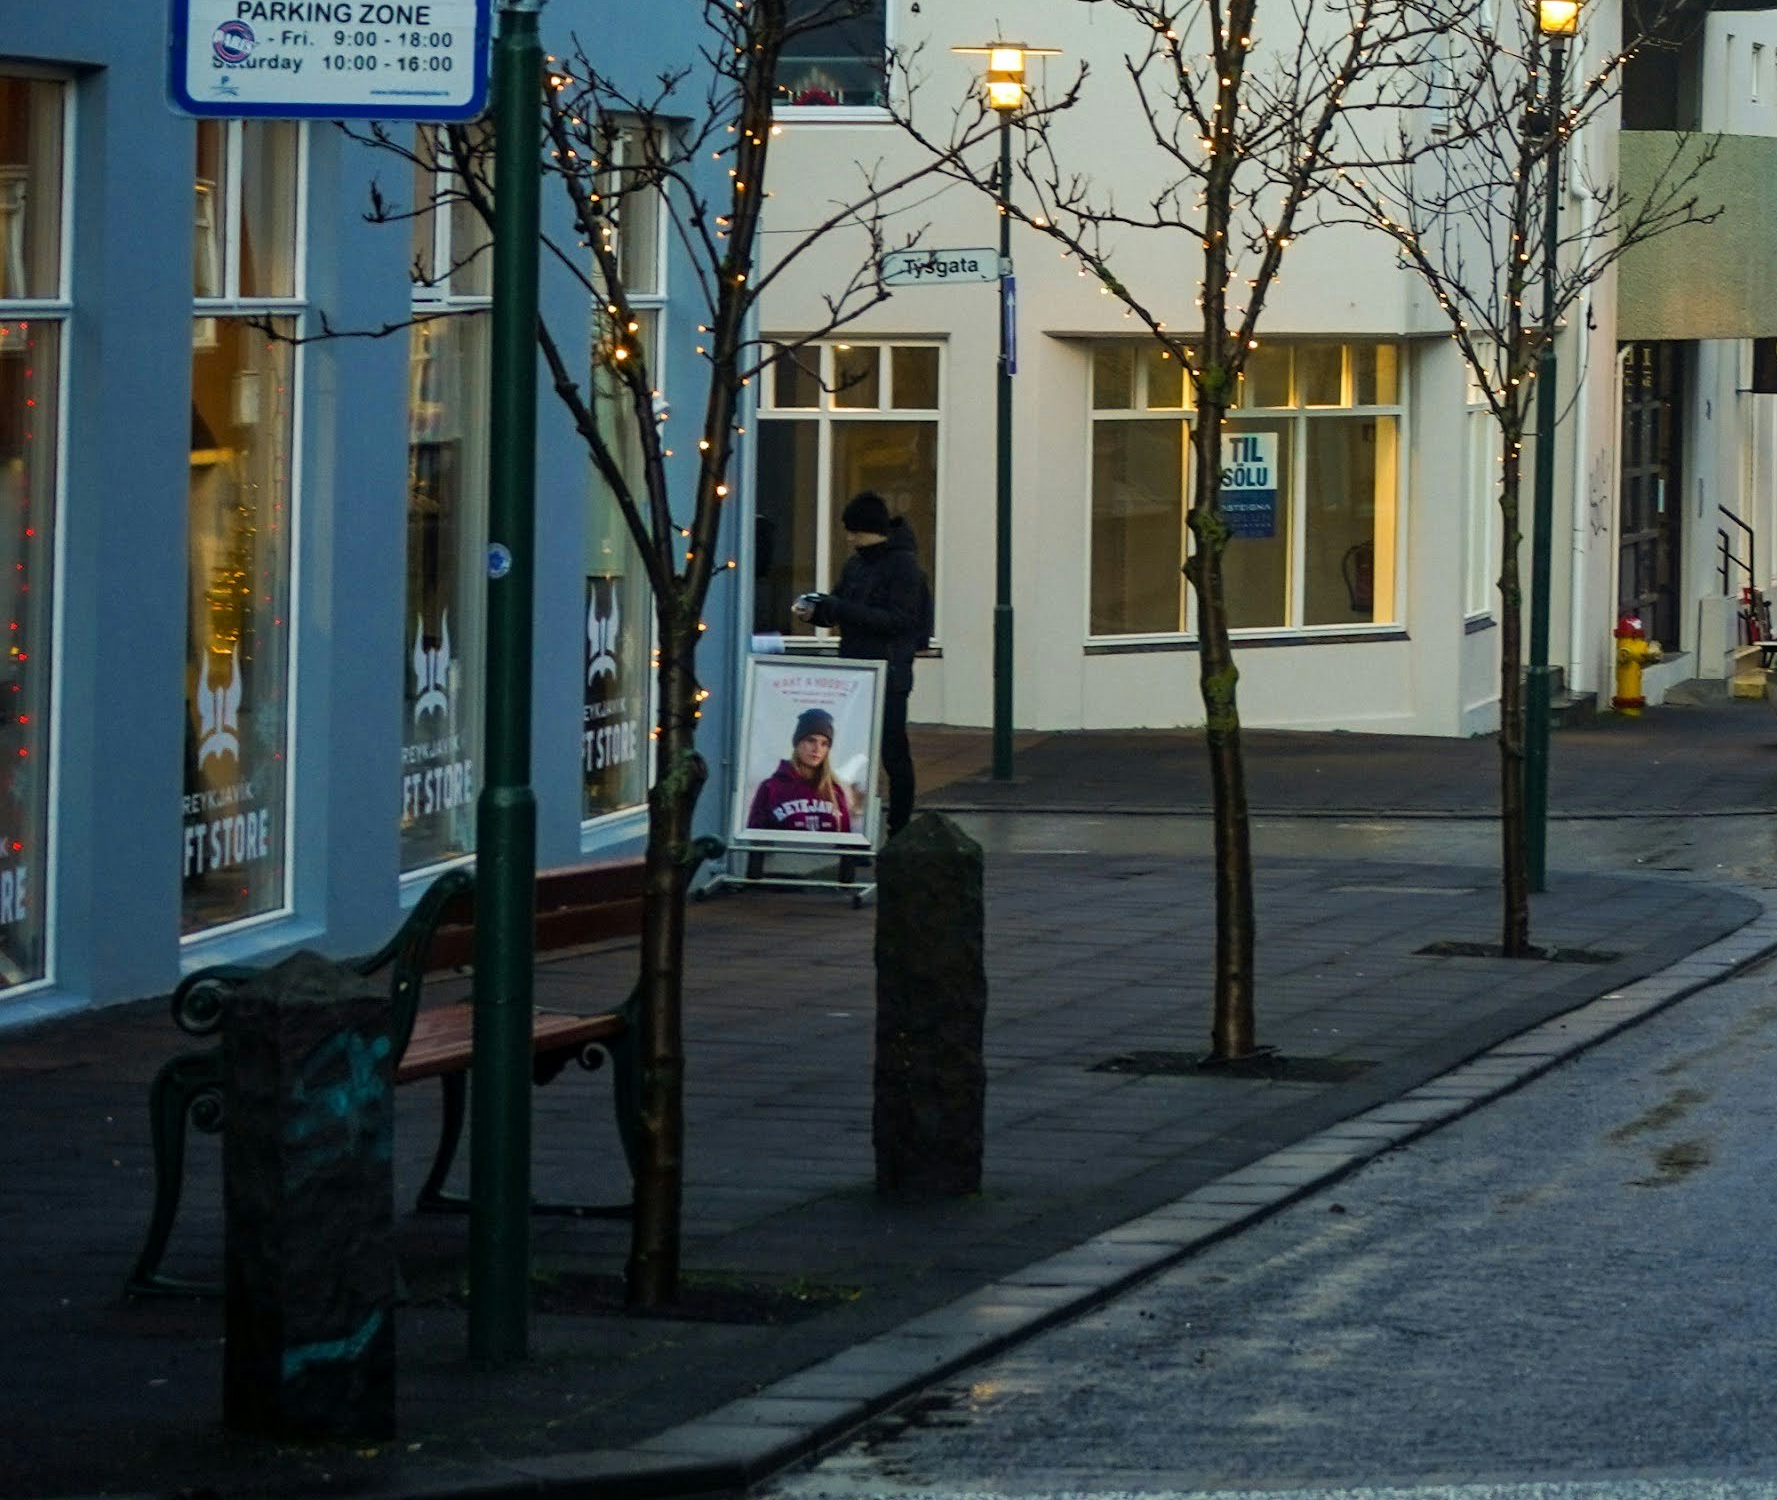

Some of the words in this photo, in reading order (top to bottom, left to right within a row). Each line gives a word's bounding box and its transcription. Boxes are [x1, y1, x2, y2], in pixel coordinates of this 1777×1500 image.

[237, 0, 352, 23] PARKING
[359, 4, 432, 26] ZONE
[281, 30, 314, 46] Fri.
[334, 30, 377, 47] 9:00
[399, 31, 452, 48] 18:00
[322, 55, 377, 71] 10:00
[397, 56, 453, 72] 16:00
[904, 258, 979, 278] Týsgata
[1229, 437, 1263, 462] TIL
[1220, 463, 1268, 488] SÖLU
[425, 759, 473, 815] STORE
[210, 808, 269, 870] STORE
